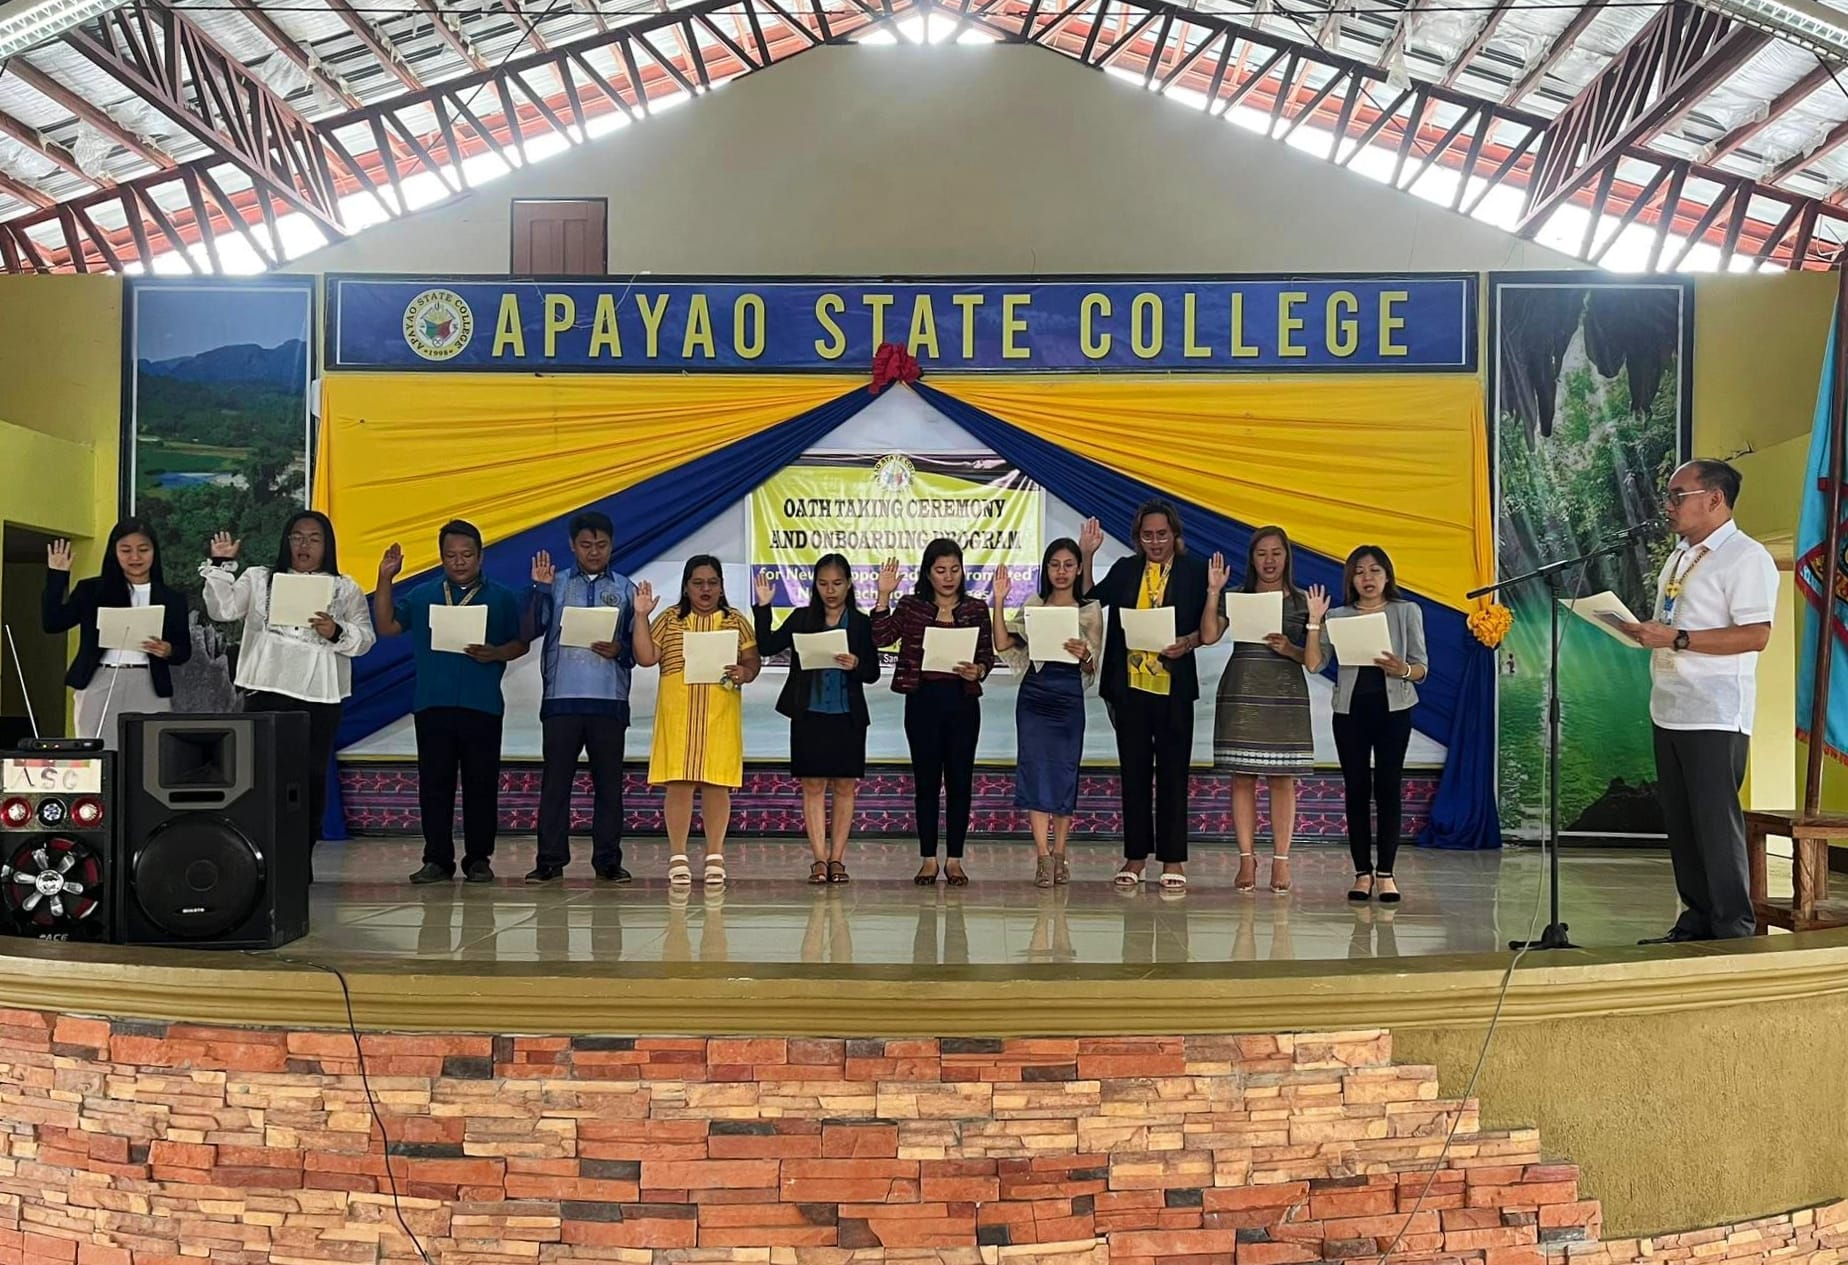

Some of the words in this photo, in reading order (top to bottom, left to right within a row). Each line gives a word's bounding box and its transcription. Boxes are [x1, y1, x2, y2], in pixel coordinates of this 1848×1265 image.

[405, 306, 425, 350] APAYAO
[417, 292, 454, 306] STATE
[454, 299, 471, 349] COLLEGE
[491, 293, 766, 359] APAYAO
[814, 293, 1031, 359] STATE
[1079, 290, 1409, 359] COLLEGE
[783, 498, 832, 518] OATH
[835, 498, 904, 518] TAKING
[907, 498, 1007, 518] CEREMONY
[769, 529, 808, 549] AND
[810, 529, 929, 549] ONBOARDING
